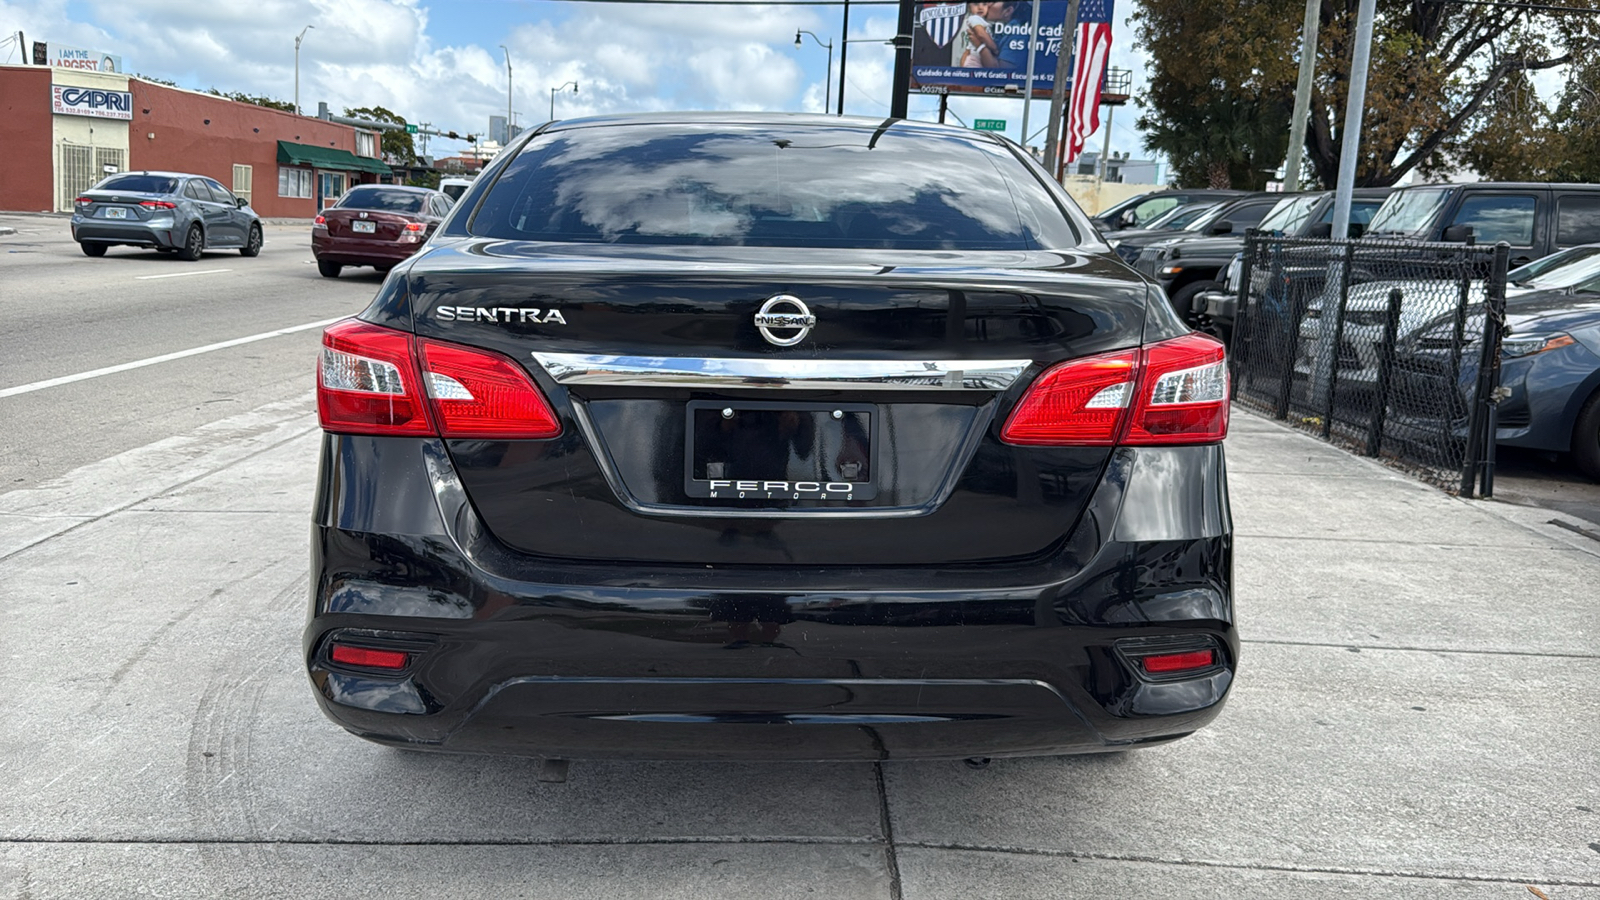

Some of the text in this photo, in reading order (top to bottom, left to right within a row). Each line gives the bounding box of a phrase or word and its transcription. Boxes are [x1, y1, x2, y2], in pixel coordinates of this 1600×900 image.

[1039, 24, 1064, 37] cad
[1009, 40, 1025, 50] es
[63, 49, 74, 59] AM
[75, 50, 88, 59] THE
[917, 69, 942, 77] Cuidado
[952, 70, 970, 78] niños
[1011, 72, 1039, 80] Escuas
[54, 87, 130, 112] BAR CAPRI
[976, 121, 987, 129] SW
[435, 305, 567, 325] SENTRA
[761, 316, 808, 326] NISSAN
[710, 480, 853, 493] FERCO
